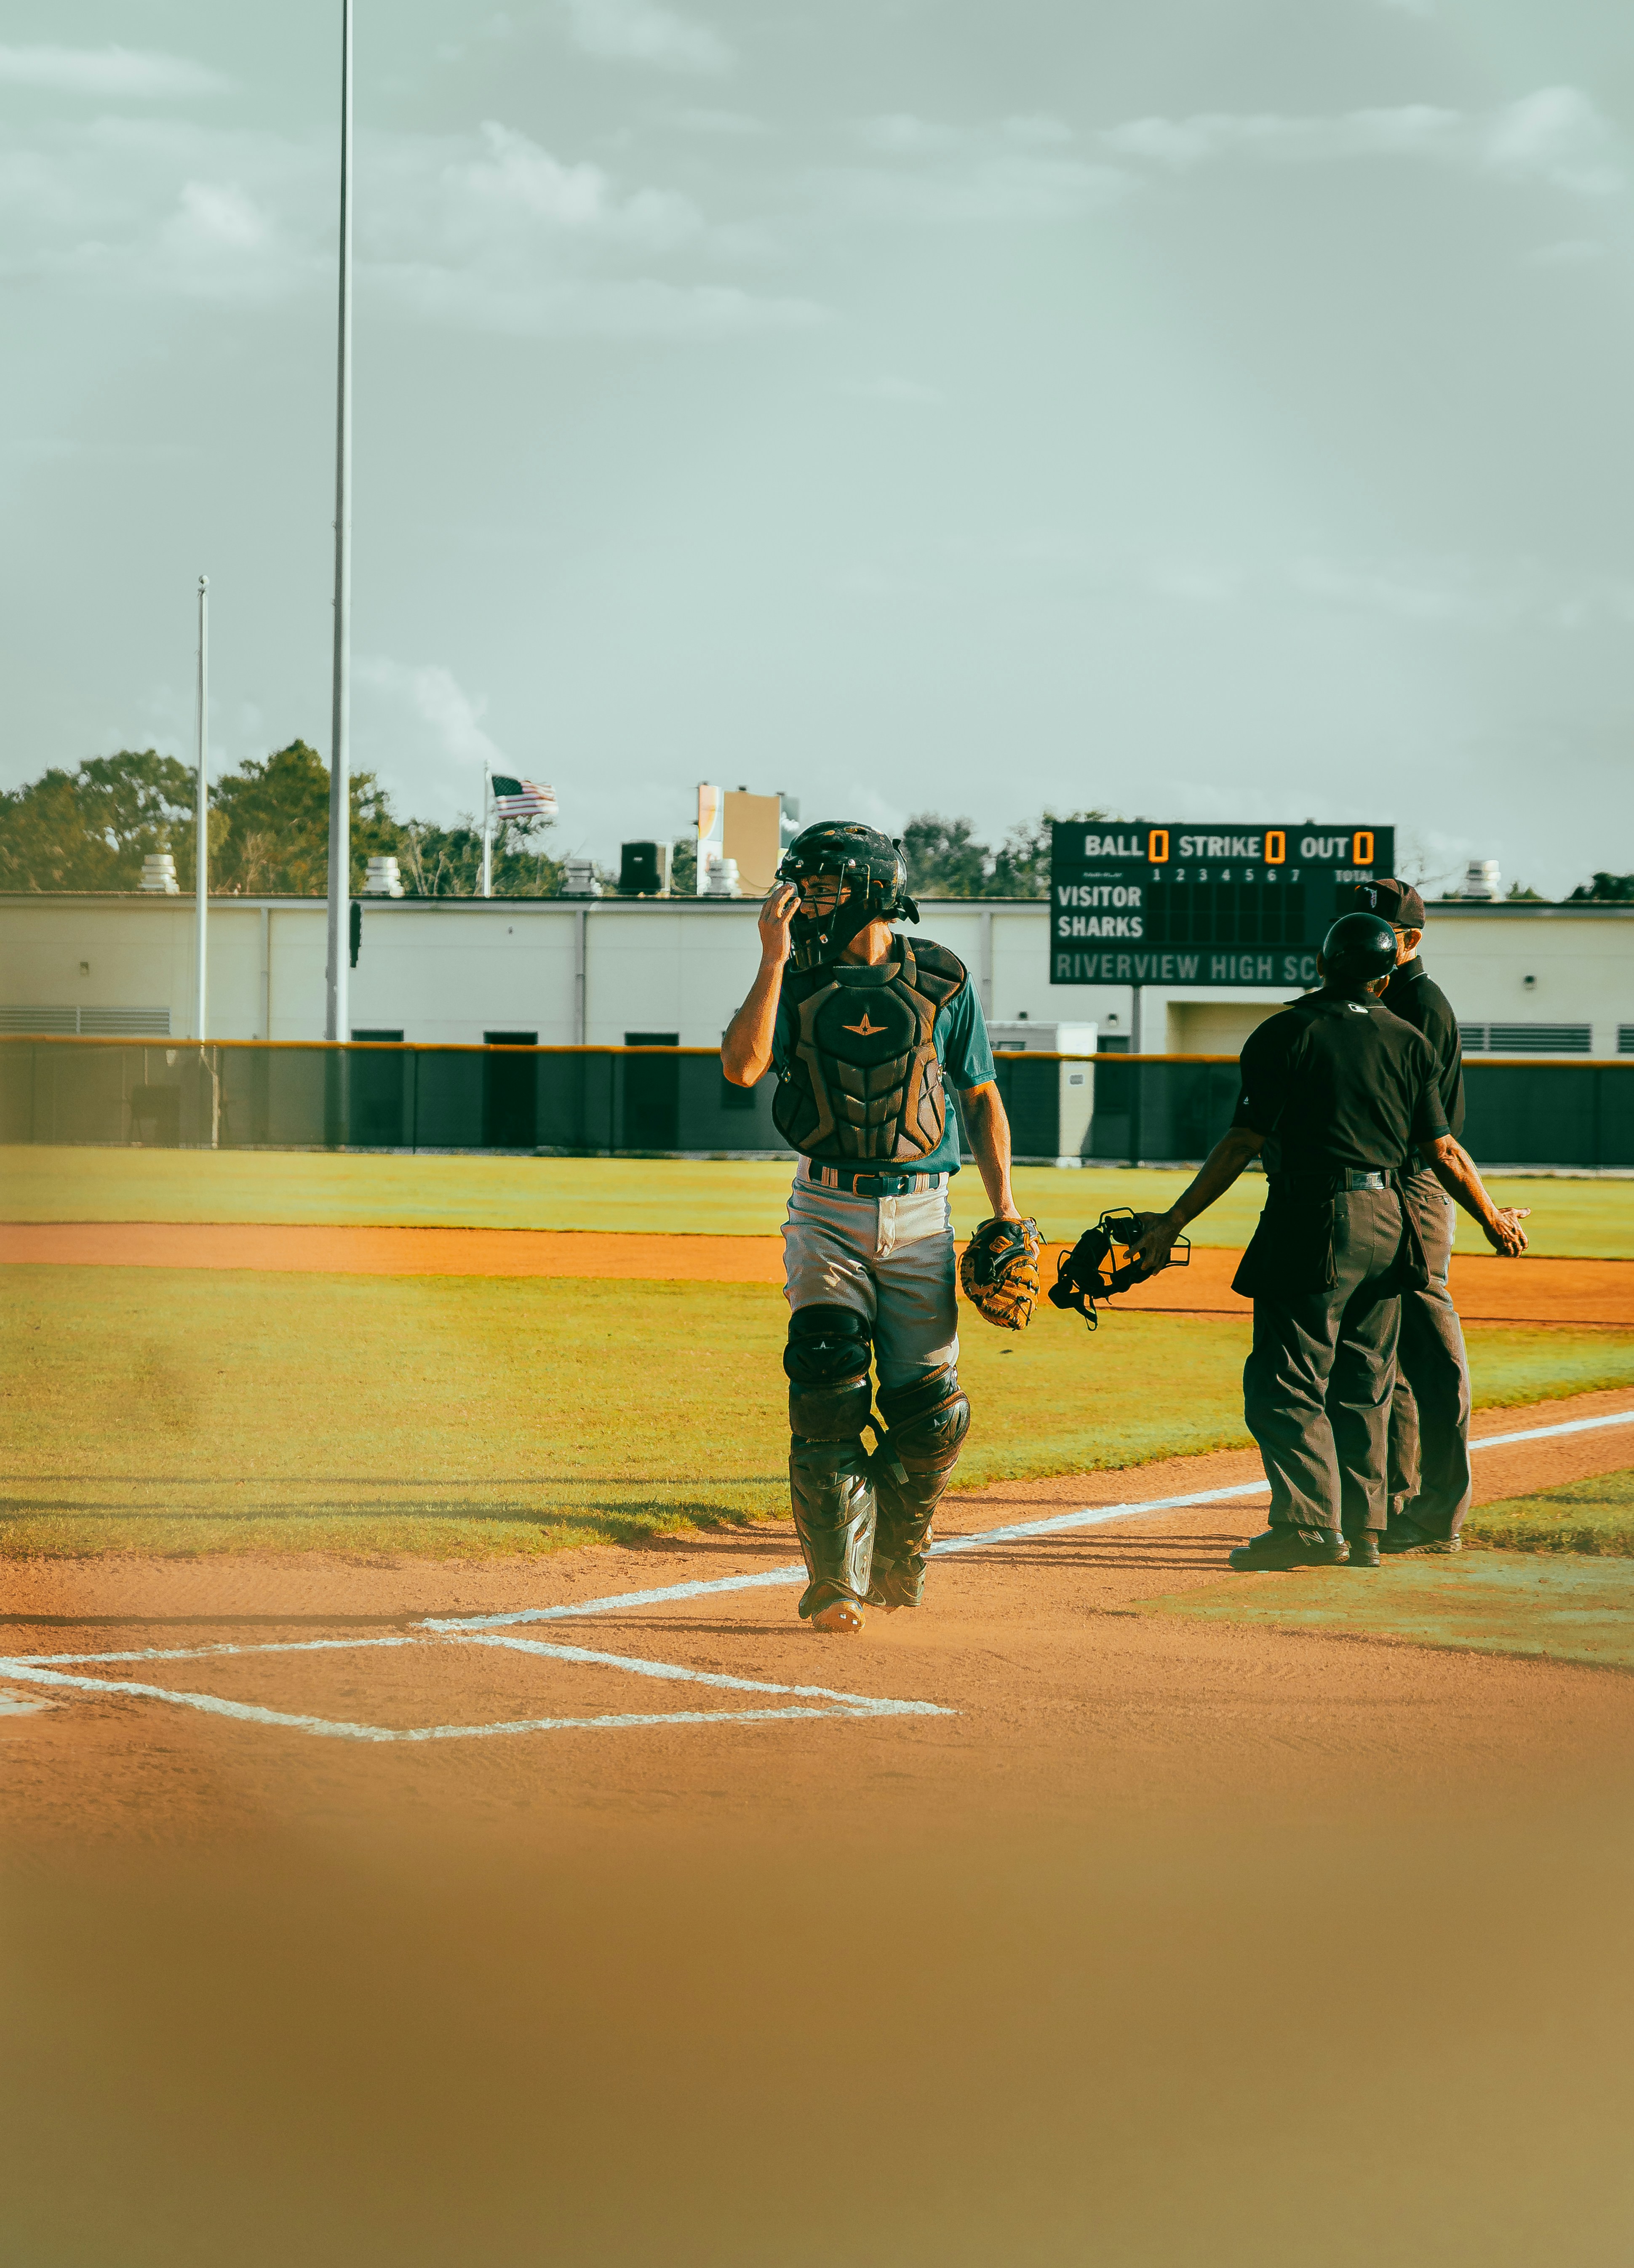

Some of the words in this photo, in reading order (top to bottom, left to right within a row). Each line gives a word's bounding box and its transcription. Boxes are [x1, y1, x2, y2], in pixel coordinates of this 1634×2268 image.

[1084, 835, 1145, 857] BALL
[1148, 830, 1169, 863] 0
[1179, 835, 1261, 858] STRIKE
[1264, 831, 1286, 865] 0
[1300, 837, 1350, 858] OUT
[1353, 832, 1374, 865] 0
[1153, 868, 1161, 881] 1
[1176, 868, 1185, 881] 2
[1199, 868, 1208, 881] 3
[1221, 869, 1231, 881] 4
[1245, 869, 1254, 881] 5
[1267, 869, 1276, 882] 6
[1292, 869, 1300, 881] 7
[1335, 870, 1373, 882] TOTAL
[1058, 886, 1141, 907] VISITOR
[1058, 916, 1143, 938] SHARKS
[1057, 953, 1199, 979] RIVERVIEW
[1211, 955, 1272, 980] HIGH
